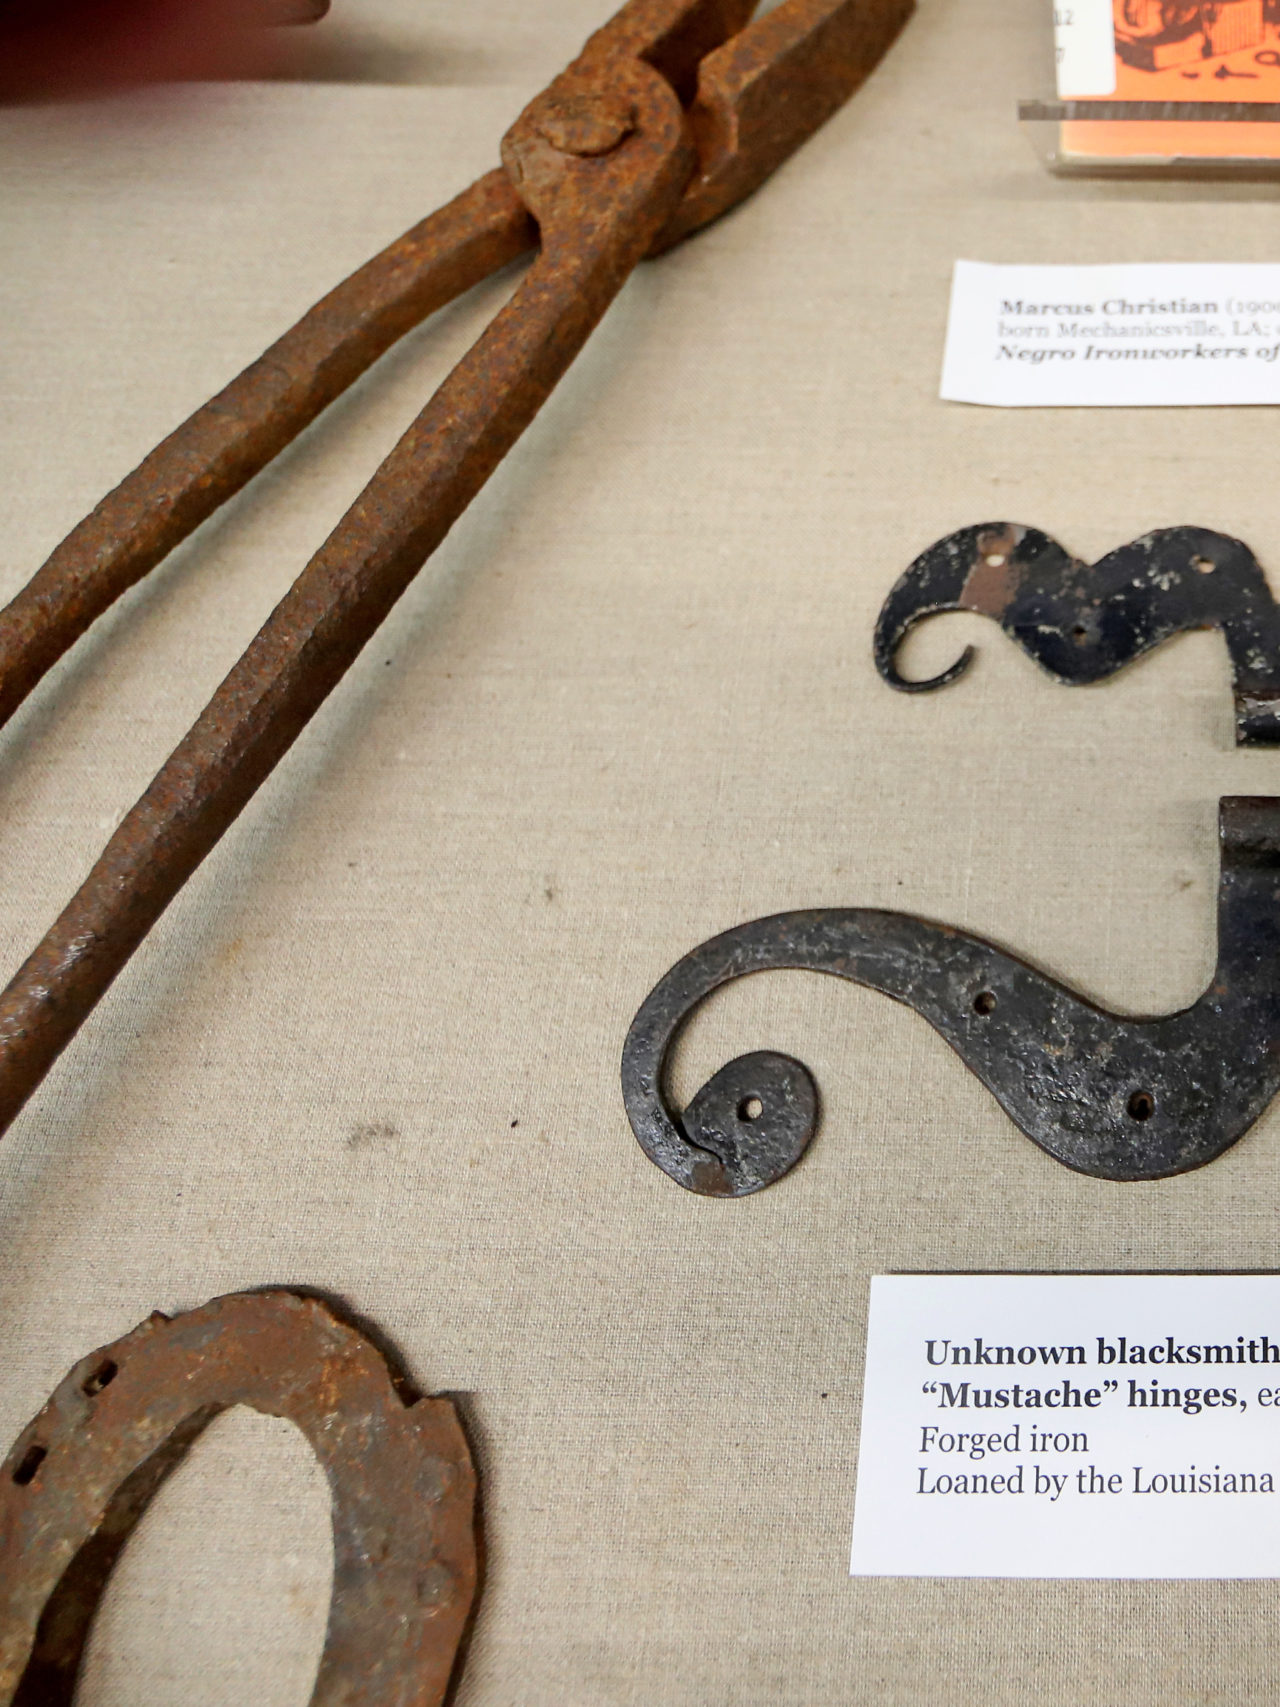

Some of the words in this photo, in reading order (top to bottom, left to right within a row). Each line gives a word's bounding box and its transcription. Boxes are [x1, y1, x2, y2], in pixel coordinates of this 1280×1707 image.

[1000, 299, 1095, 315] Marcus
[1101, 298, 1218, 315] Christian
[997, 319, 1050, 338] born
[1056, 319, 1225, 338] Mechanicsville,
[1231, 319, 1270, 338] LA;
[995, 344, 1076, 364] Negro
[1083, 343, 1248, 360] Ironworkers
[924, 1338, 1087, 1365] Unknown
[1095, 1336, 1280, 1364] blacksmith
[921, 1380, 1118, 1408] “Mustache”
[1126, 1379, 1247, 1415] hinges,
[918, 1424, 1021, 1460] Forged
[1029, 1424, 1089, 1452] iron
[915, 1465, 1024, 1494] Loaned
[1032, 1465, 1068, 1501] by
[1075, 1465, 1122, 1494] the
[1131, 1465, 1275, 1493] Louisiana
